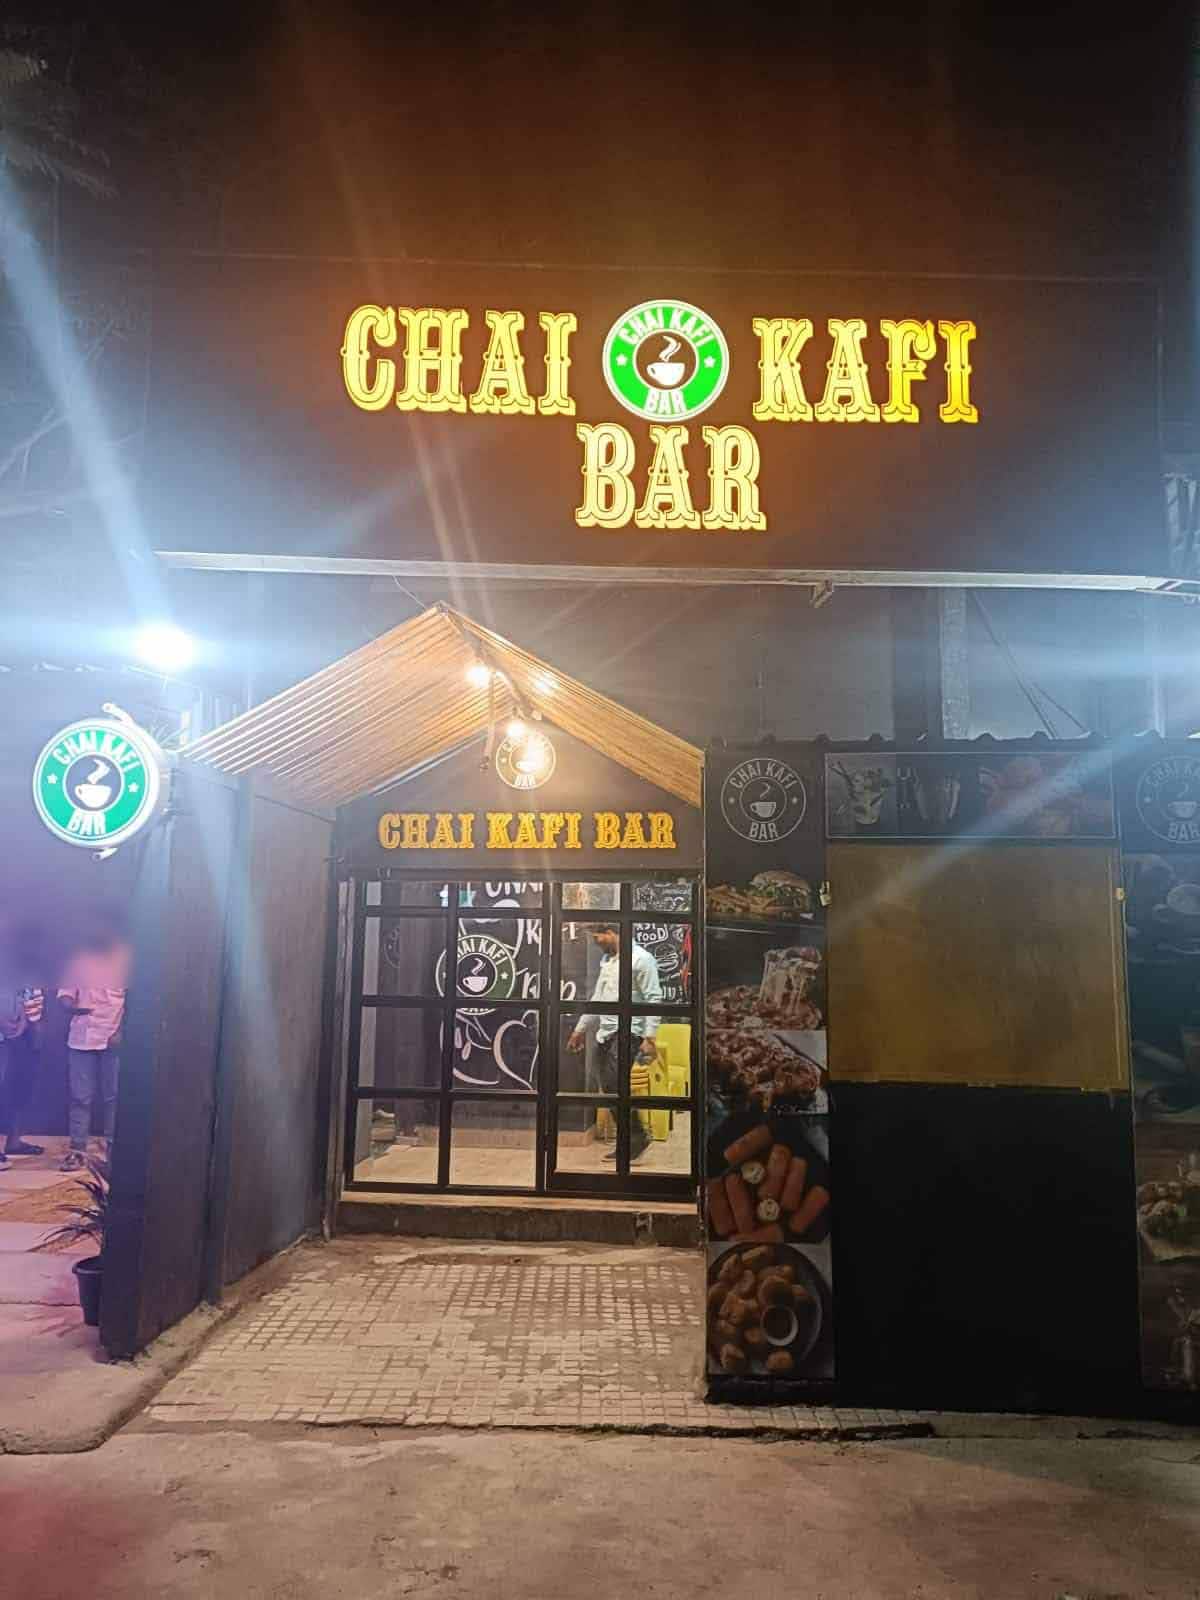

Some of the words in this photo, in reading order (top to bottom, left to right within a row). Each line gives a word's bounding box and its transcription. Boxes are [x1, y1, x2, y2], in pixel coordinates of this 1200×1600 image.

[618, 307, 664, 345] CHAI
[668, 307, 716, 348] KAFI
[341, 304, 577, 416] CHAI
[752, 318, 979, 424] KAFI
[643, 387, 688, 416] BAR
[575, 423, 767, 531] BAR
[52, 731, 98, 765] CHAI
[100, 733, 141, 774] KAFI
[729, 761, 761, 790] CHAI
[766, 761, 798, 790] KAFI
[66, 809, 107, 837] BAR
[377, 811, 475, 850] CHAI
[486, 811, 582, 850] KAFI
[593, 811, 677, 850] BAR
[748, 822, 779, 840] BAR
[478, 938, 508, 966] KAFI
